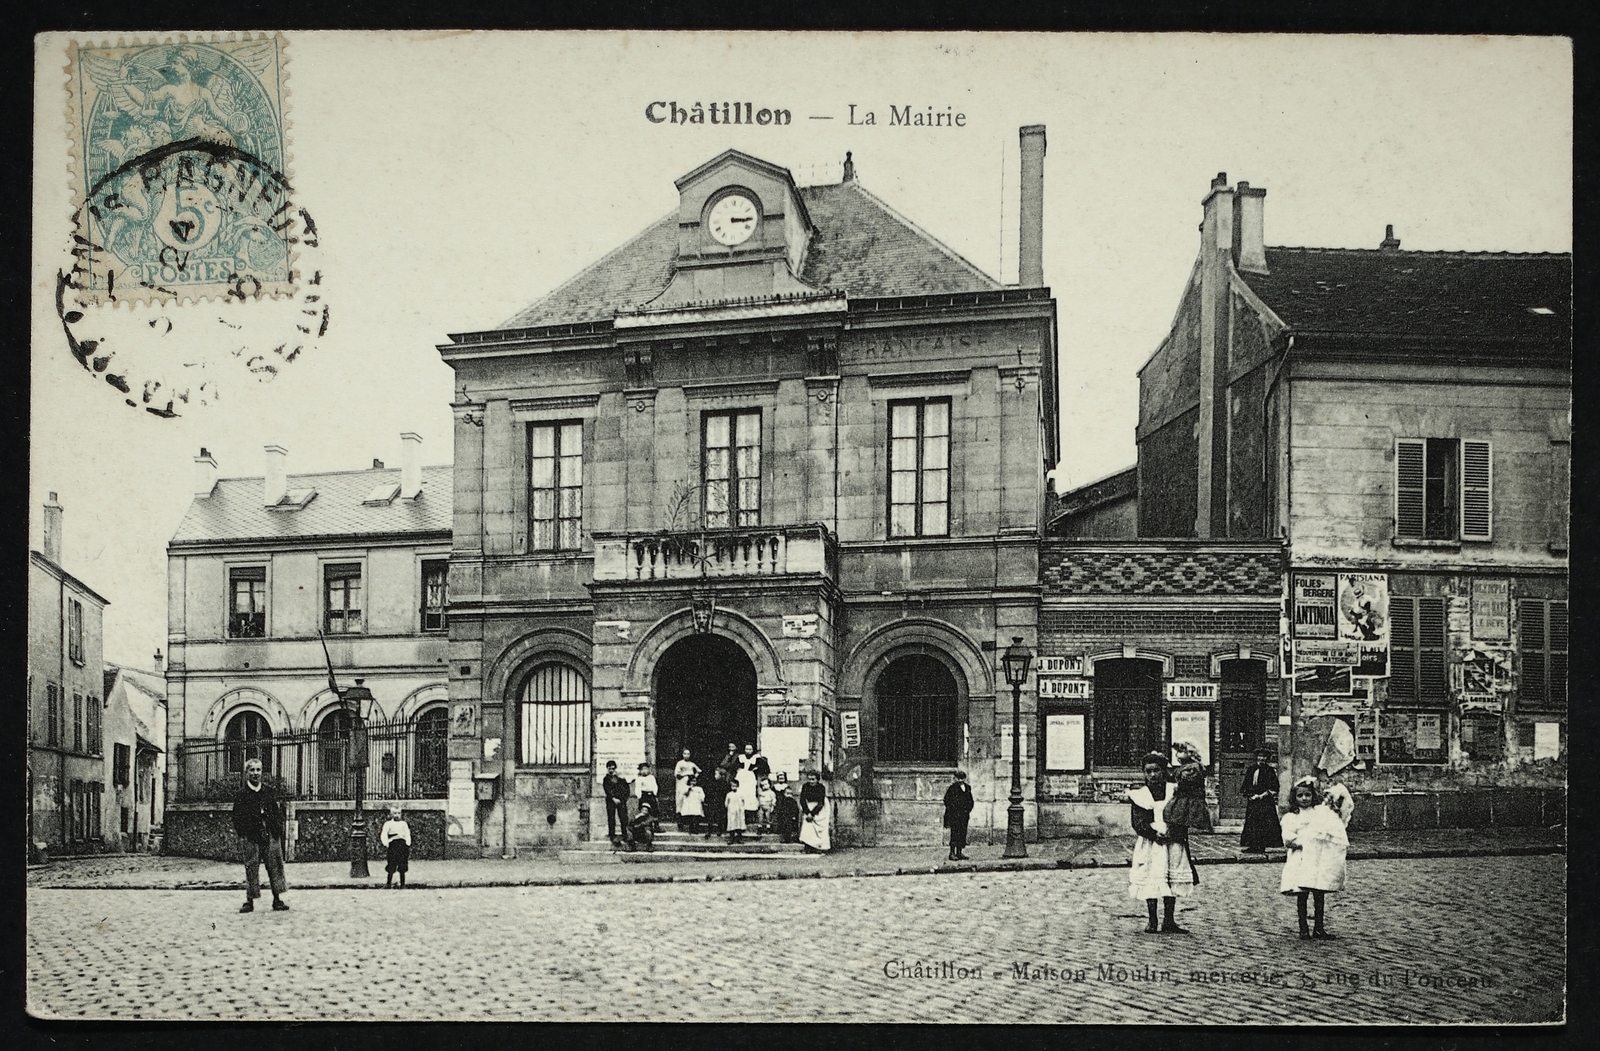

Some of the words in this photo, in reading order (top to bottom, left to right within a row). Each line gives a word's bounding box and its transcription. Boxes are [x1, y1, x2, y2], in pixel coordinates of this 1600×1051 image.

[145, 258, 232, 284] POSTES
[1340, 573, 1386, 582] PARISIANA
[1047, 659, 1082, 671] DUPONT
[1051, 682, 1086, 694] DUPONT
[1179, 685, 1214, 697] DUPONT
